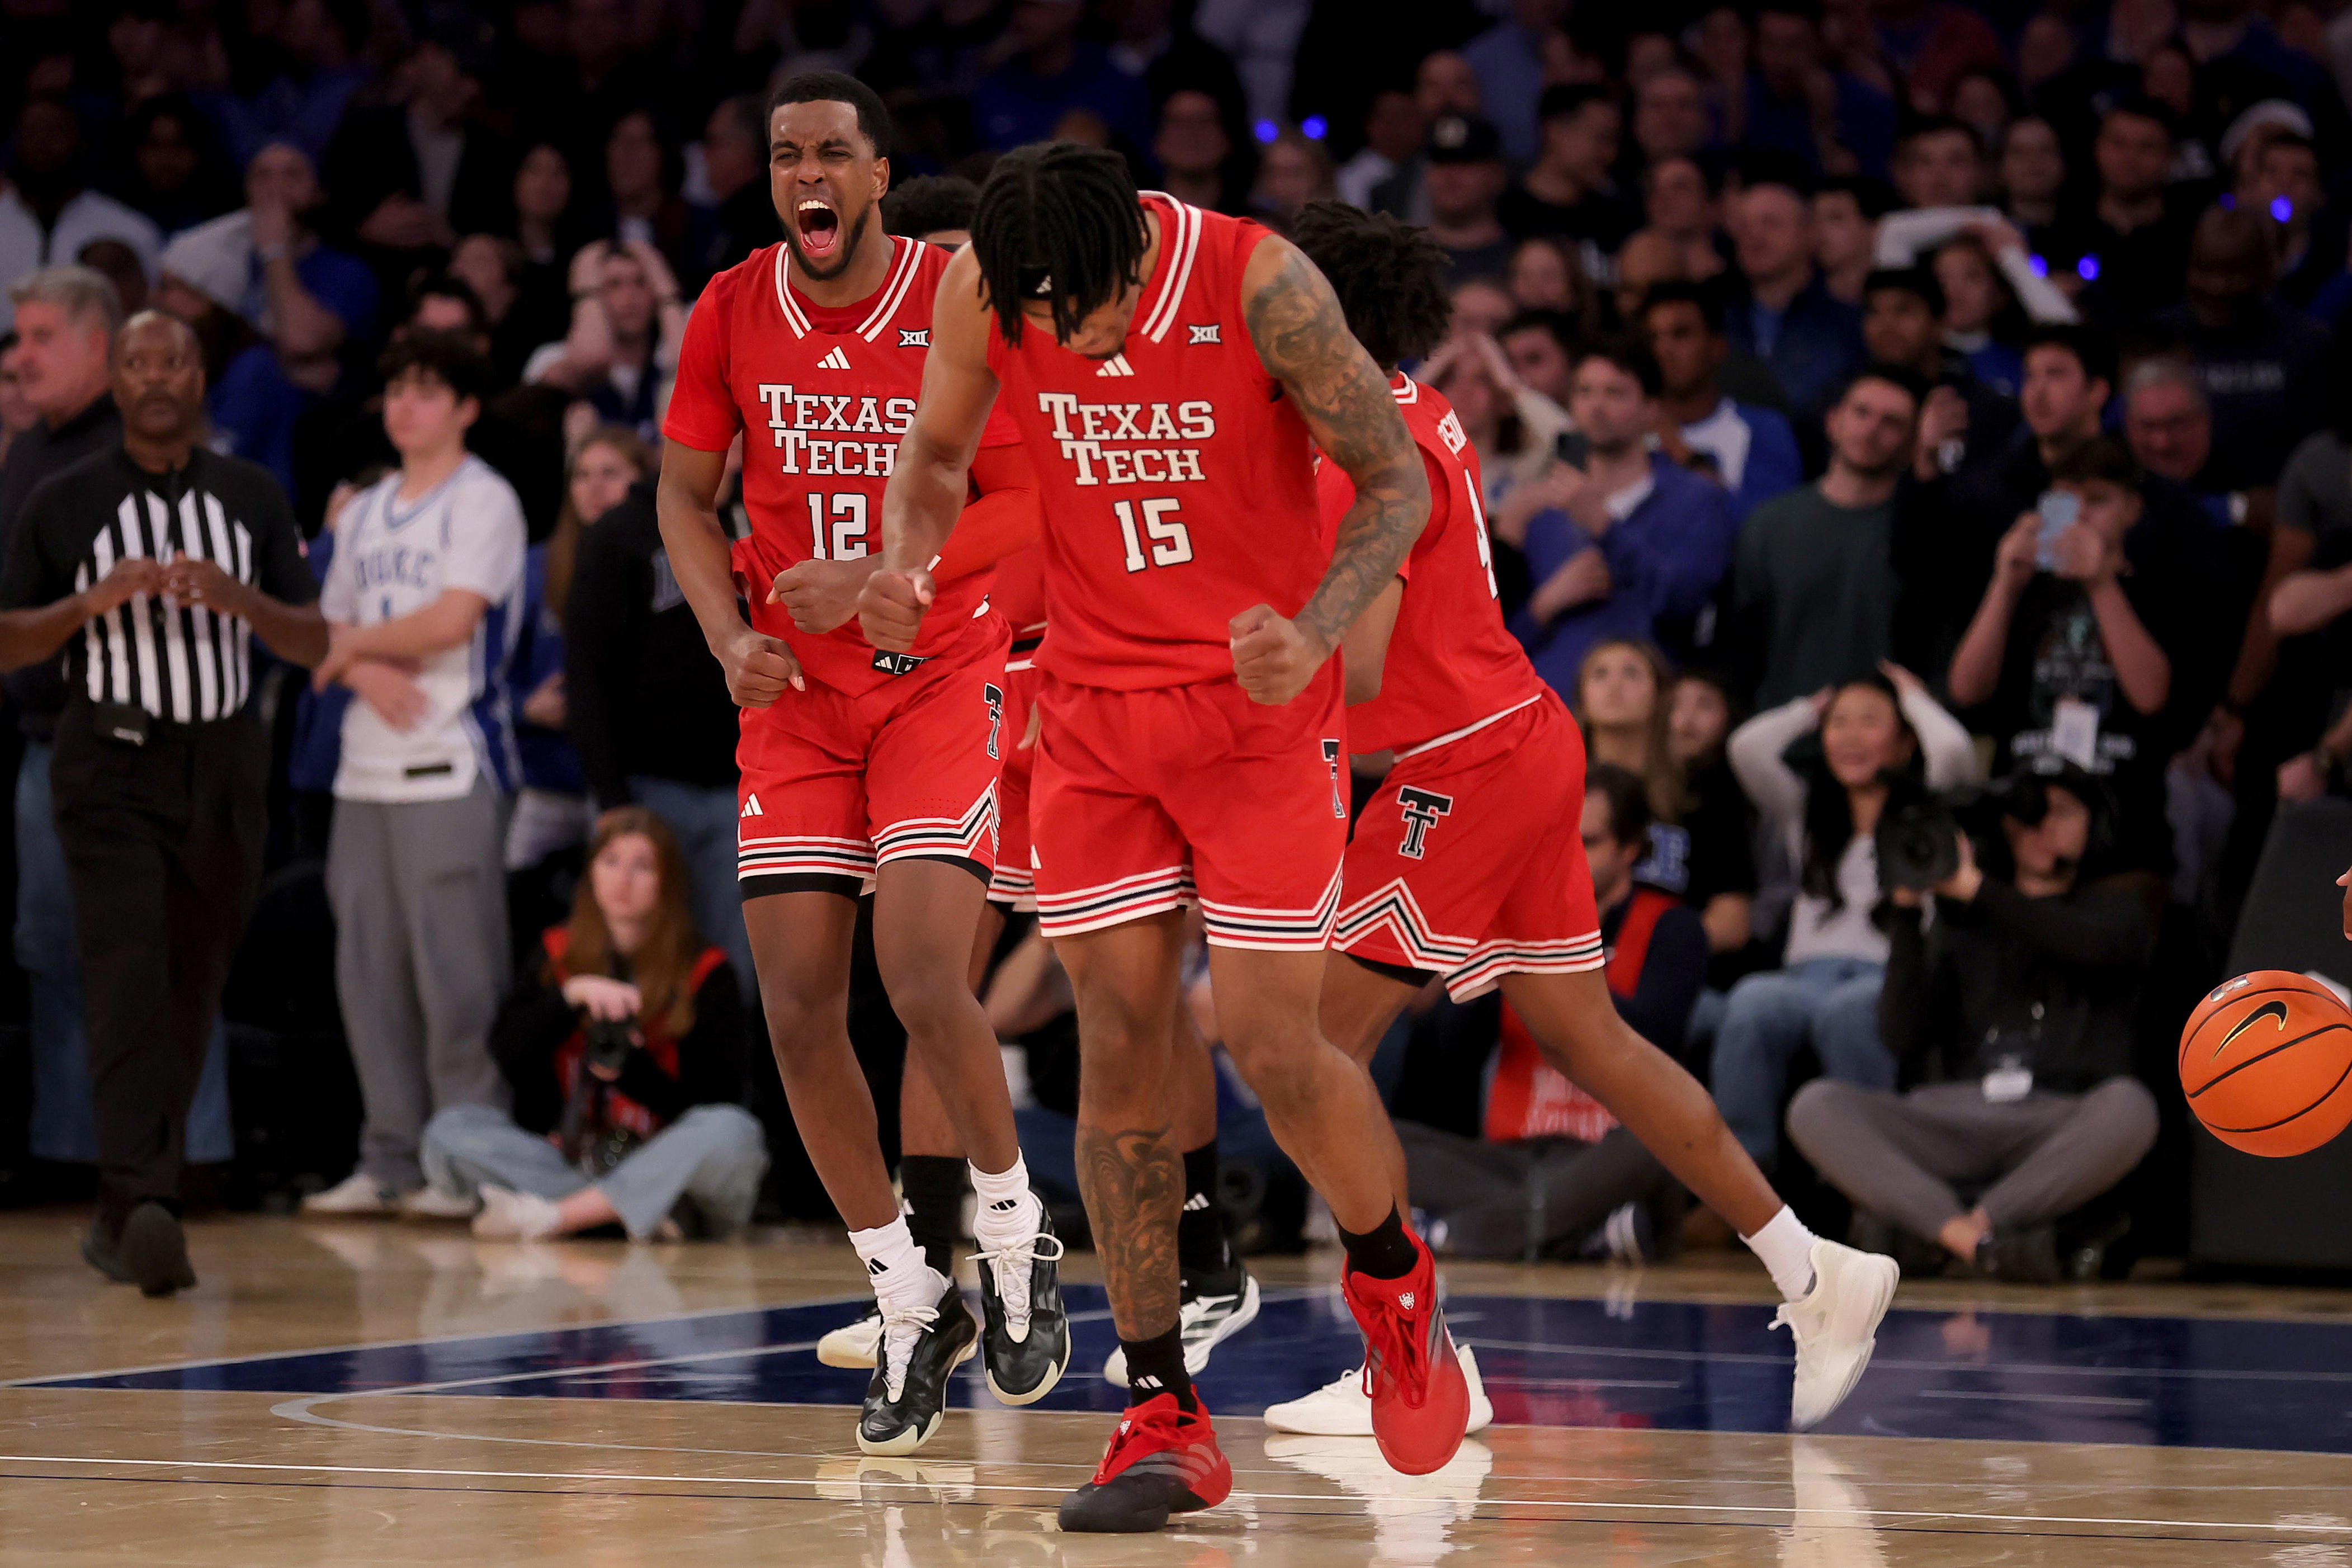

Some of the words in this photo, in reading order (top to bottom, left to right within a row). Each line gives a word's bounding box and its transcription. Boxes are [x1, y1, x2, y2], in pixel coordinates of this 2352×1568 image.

[758, 384, 917, 434] TEXAS
[1038, 392, 1216, 441] TEXAS
[774, 428, 898, 476] TECH
[1060, 440, 1206, 485] TECH
[807, 492, 867, 561] 12
[1113, 497, 1193, 573] 15
